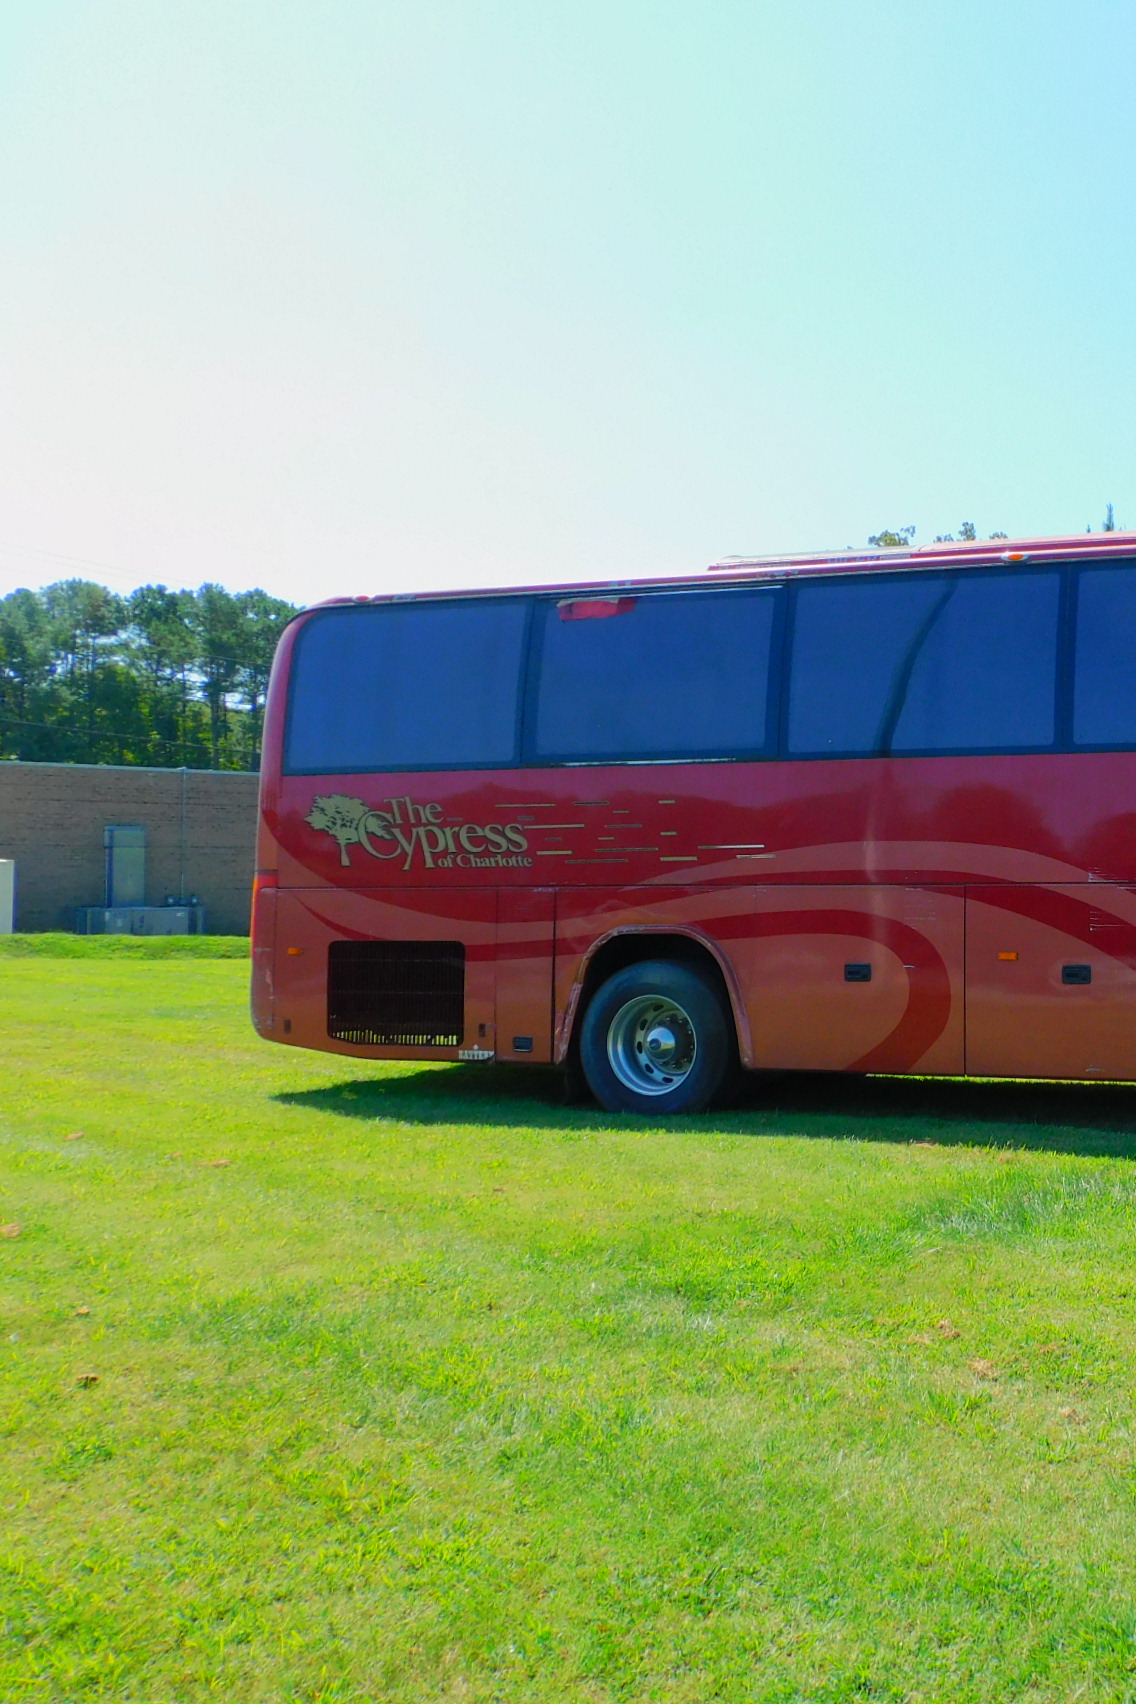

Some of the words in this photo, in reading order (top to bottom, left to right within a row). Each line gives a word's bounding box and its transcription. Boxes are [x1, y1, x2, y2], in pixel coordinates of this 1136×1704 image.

[383, 796, 443, 824] The
[358, 810, 528, 870] Cypress
[438, 855, 454, 868] of
[456, 854, 533, 868] Charlotte
